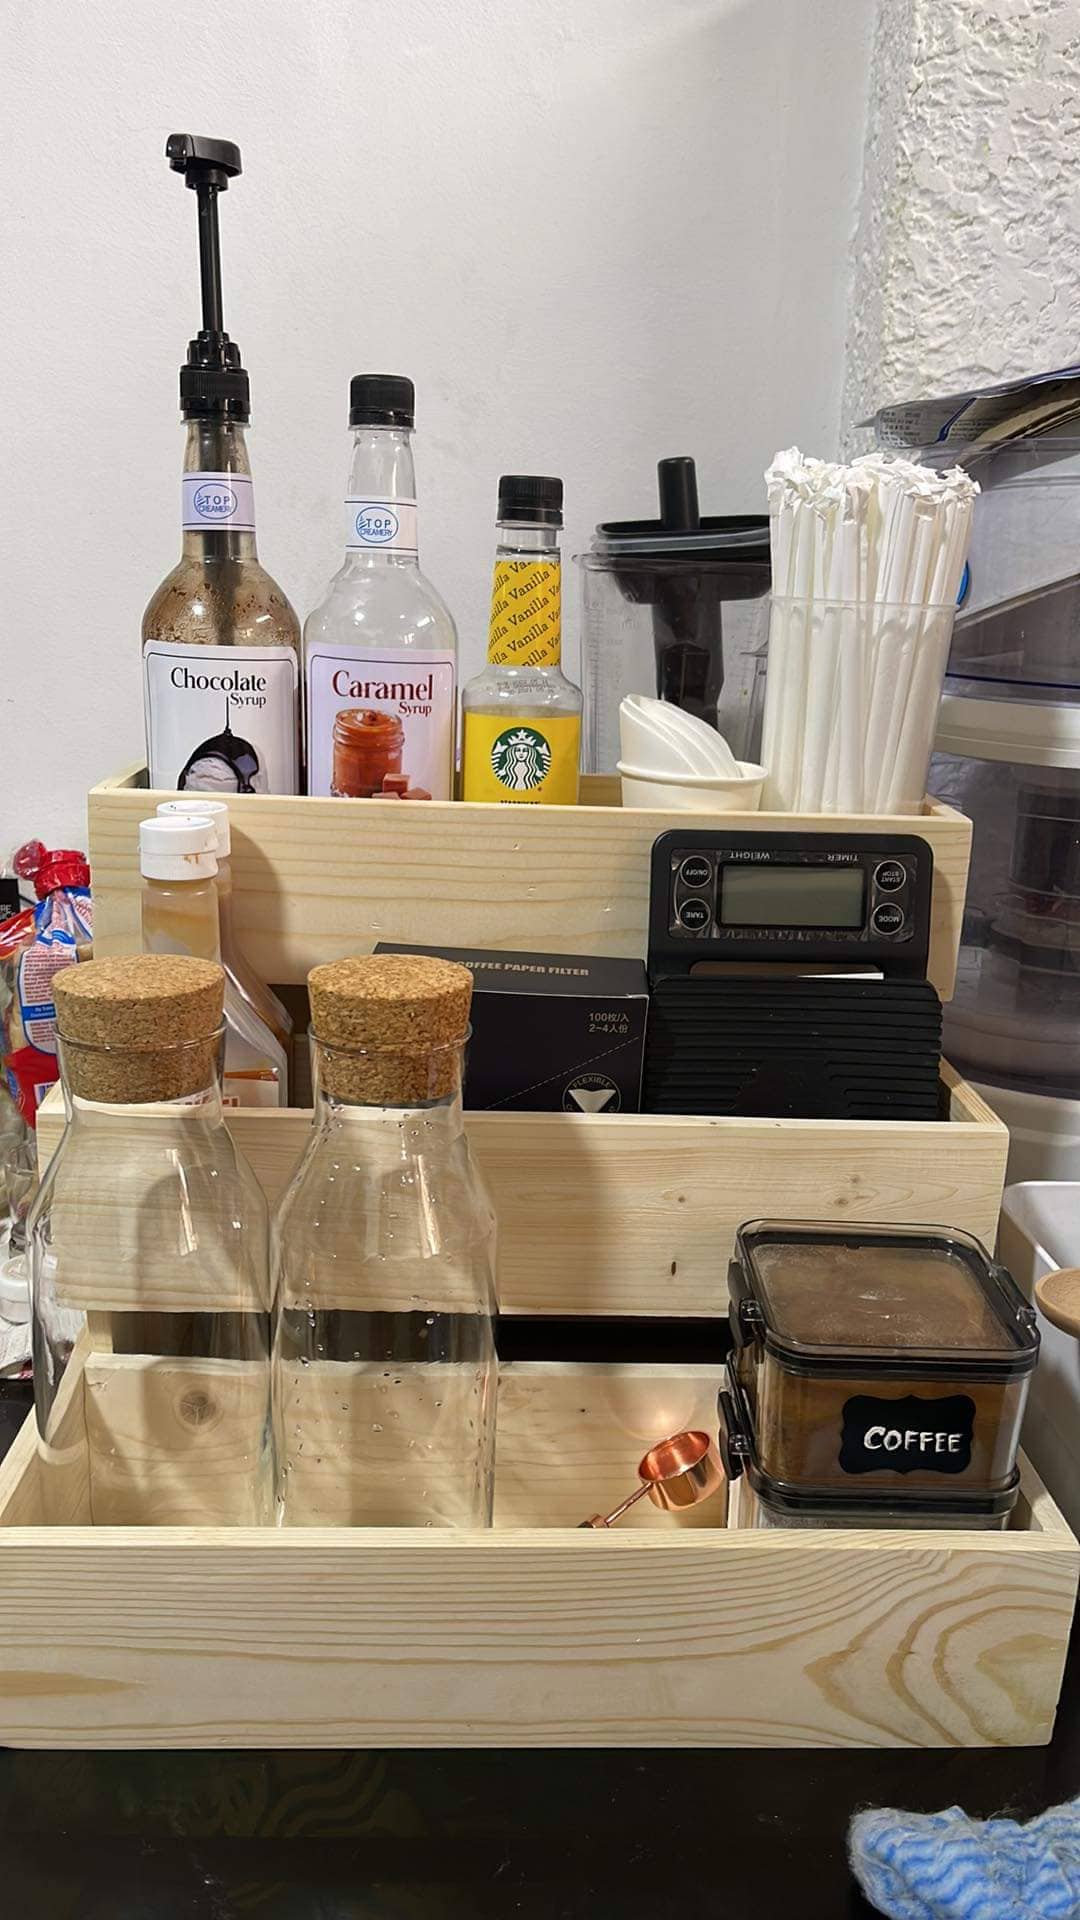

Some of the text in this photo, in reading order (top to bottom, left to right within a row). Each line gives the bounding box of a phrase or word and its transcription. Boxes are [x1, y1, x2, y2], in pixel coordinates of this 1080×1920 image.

[204, 495, 231, 505] TOP
[365, 518, 391, 529] TOP
[508, 570, 551, 600] Vanilla
[508, 597, 549, 626] Vanilla
[507, 623, 549, 652] Vanilla
[170, 666, 267, 692] Chocolate
[331, 669, 433, 701] Caramel
[229, 692, 267, 709] Syrup
[398, 701, 432, 717] Syrup
[728, 851, 770, 860] WEIGHT
[827, 854, 859, 862] TIMER
[685, 911, 704, 919] TARE
[878, 915, 900, 923] MODE
[503, 962, 546, 974] PAPER
[548, 966, 590, 977] FILTER
[572, 1075, 611, 1089] FLEXIBLE
[863, 1425, 964, 1453] COFFEE
